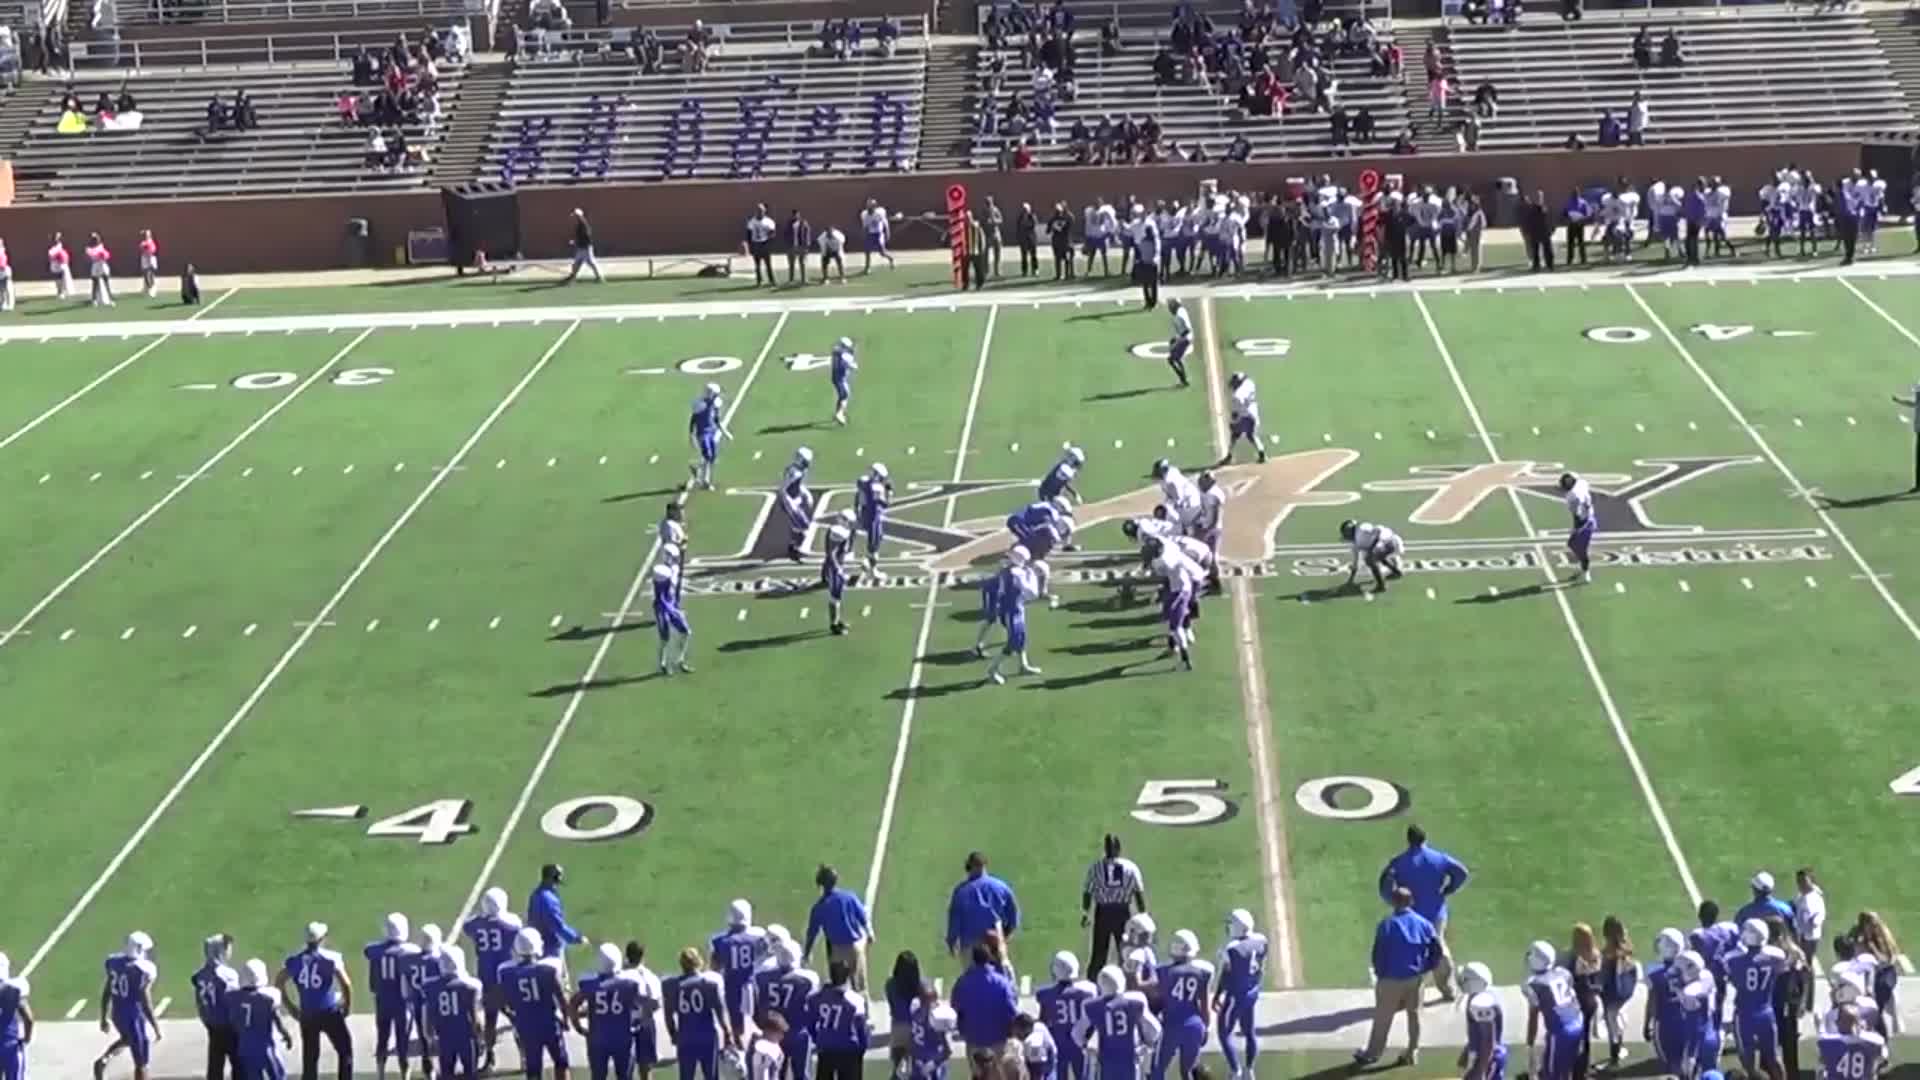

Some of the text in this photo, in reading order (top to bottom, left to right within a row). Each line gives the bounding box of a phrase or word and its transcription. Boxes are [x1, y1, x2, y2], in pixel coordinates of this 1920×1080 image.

[1107, 864, 1122, 886] L
[476, 929, 502, 952] 33
[381, 955, 395, 981] 11
[730, 945, 752, 969] 18
[111, 970, 129, 998] 20
[298, 962, 322, 989] 46
[1745, 966, 1772, 992] 87
[518, 977, 540, 1002] 51
[678, 989, 704, 1013] 60
[767, 983, 794, 1008] 57
[1171, 977, 1198, 1001] 49
[241, 1003, 252, 1028] 7
[438, 991, 459, 1016] 81
[594, 991, 623, 1015] 56
[818, 1003, 843, 1030] 97
[1104, 1010, 1128, 1036] 13
[1836, 1050, 1865, 1079] 48
